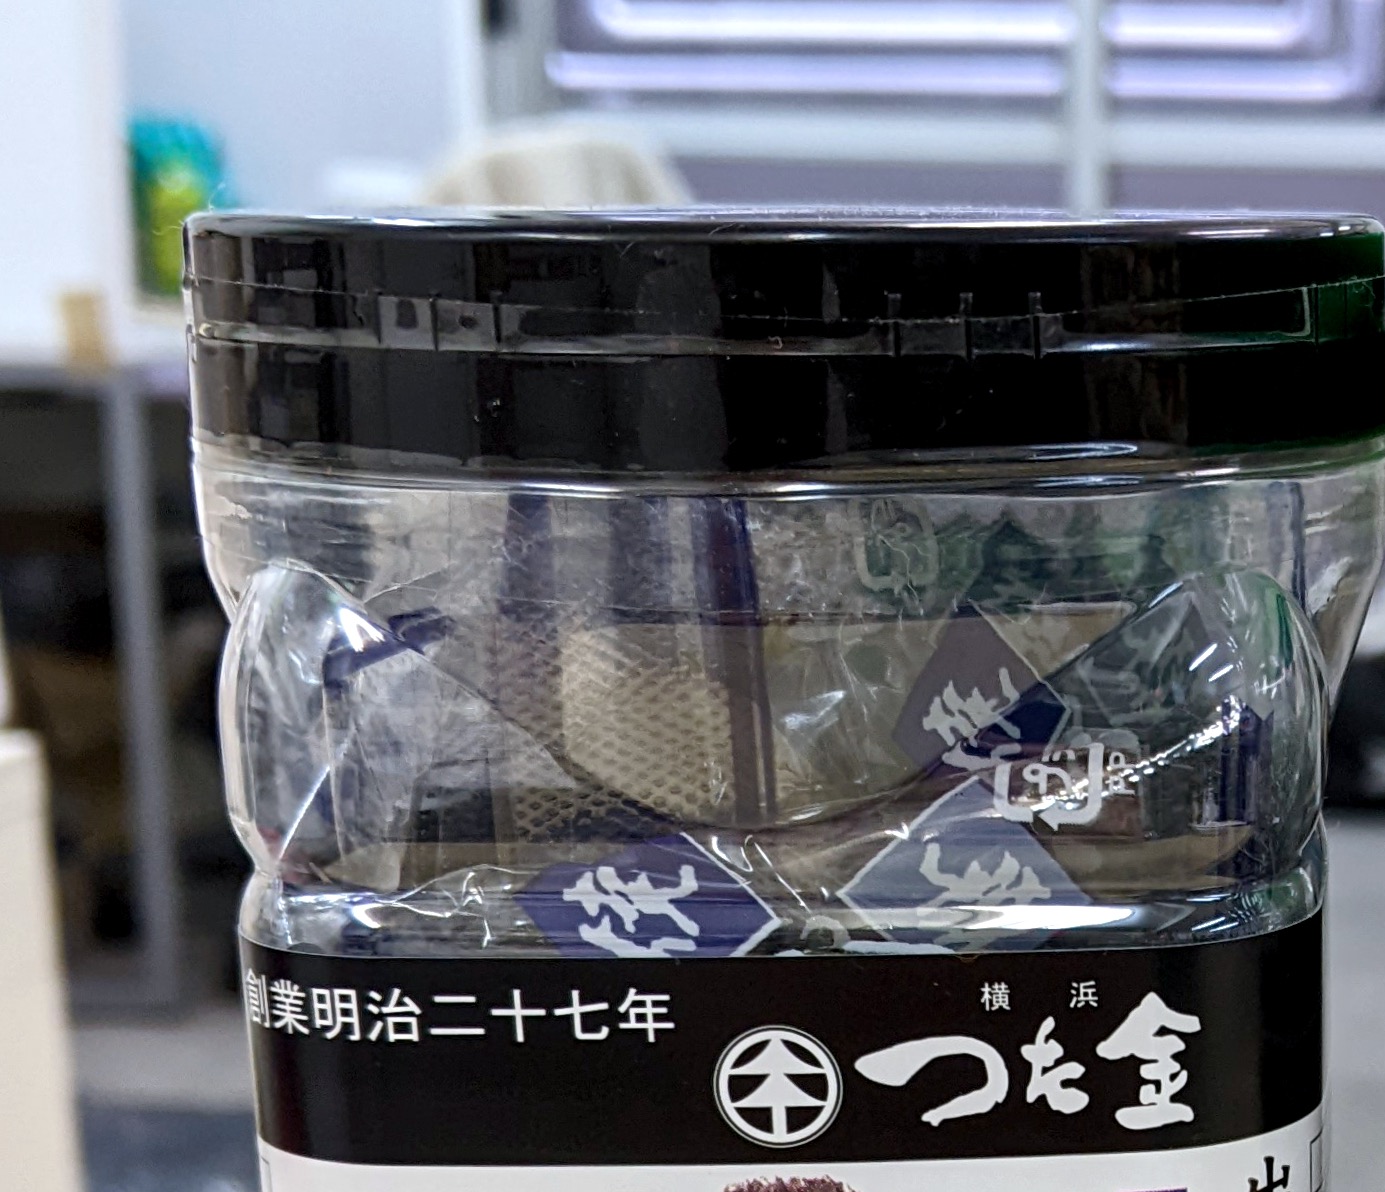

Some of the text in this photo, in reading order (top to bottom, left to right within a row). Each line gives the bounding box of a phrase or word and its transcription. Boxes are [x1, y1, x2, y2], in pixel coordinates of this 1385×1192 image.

[244, 965, 676, 1044] 創業明治二十七年
[980, 981, 1099, 1011] 横浜
